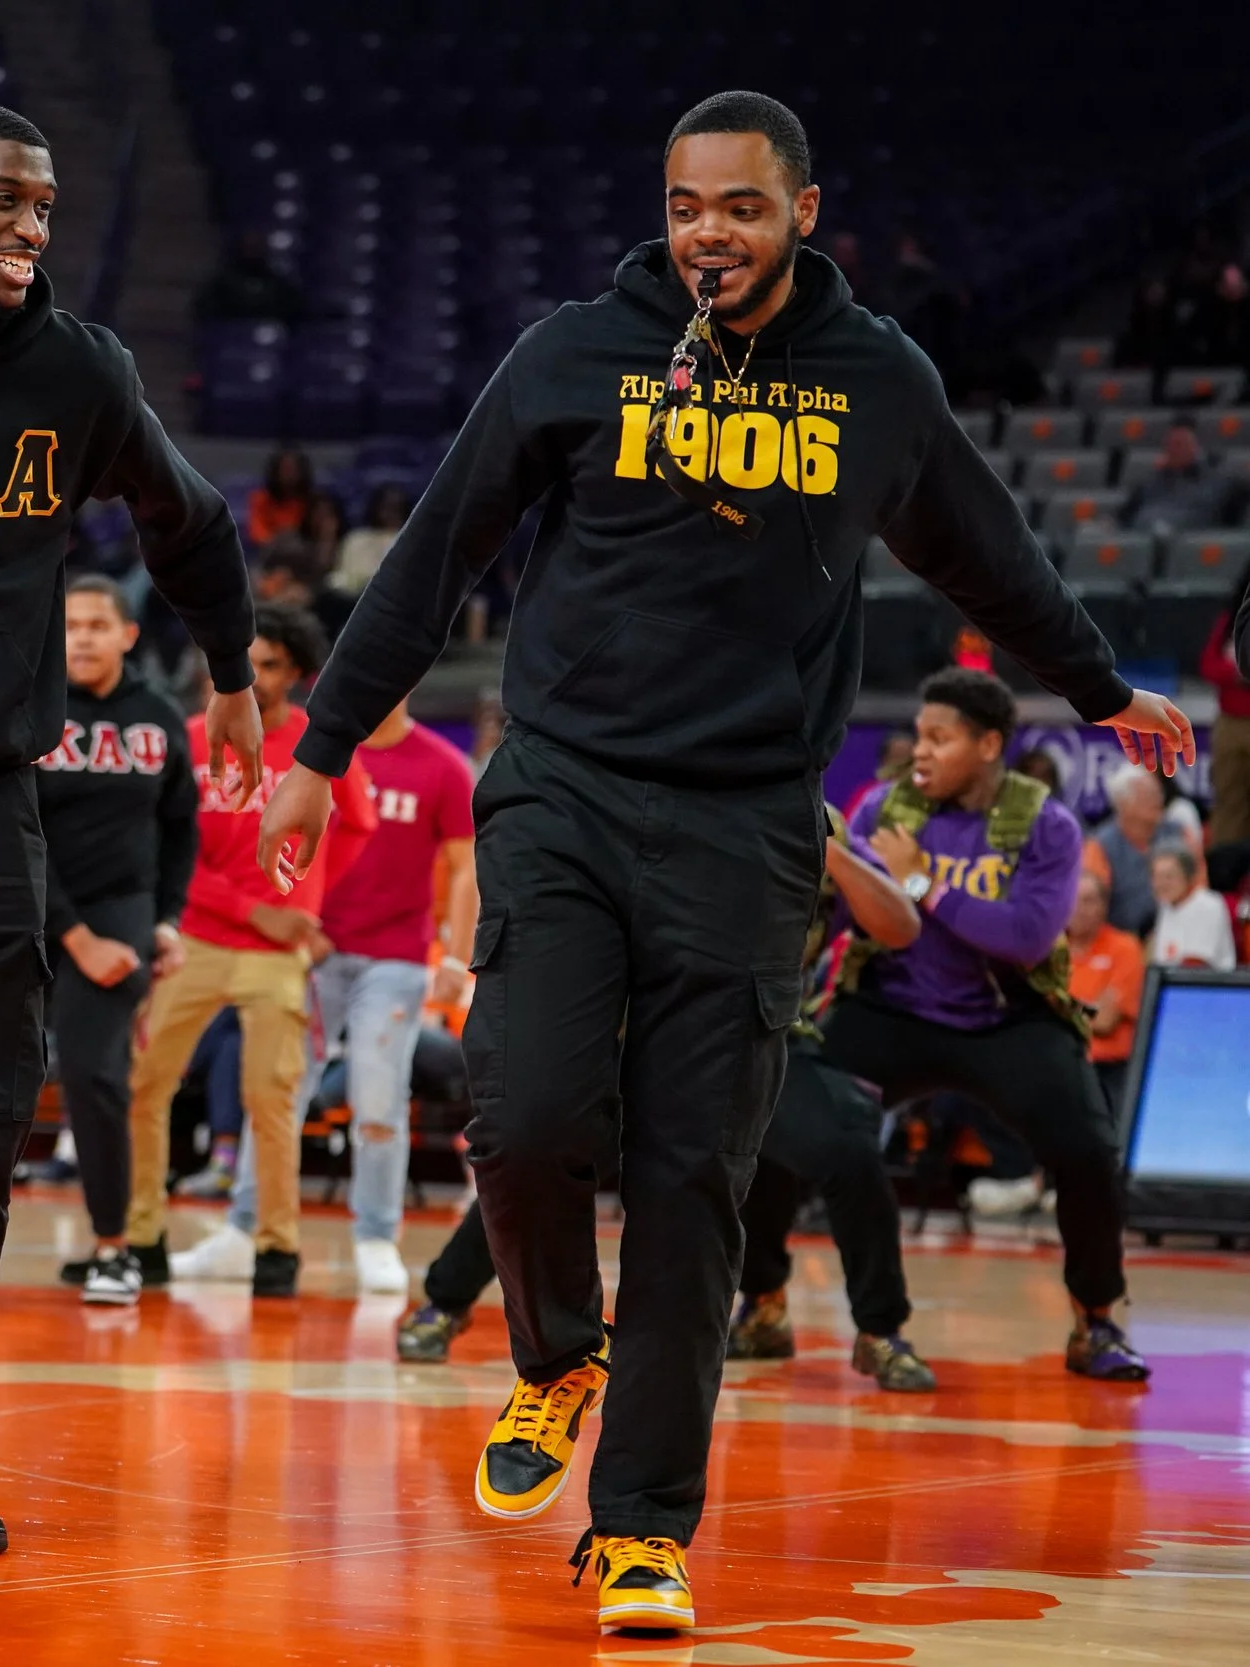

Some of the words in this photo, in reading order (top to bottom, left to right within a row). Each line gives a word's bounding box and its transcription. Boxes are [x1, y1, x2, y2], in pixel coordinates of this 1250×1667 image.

[619, 374, 703, 404] Alpa
[712, 379, 759, 406] Phi
[614, 404, 840, 495] 1906
[711, 500, 749, 526] 1906
